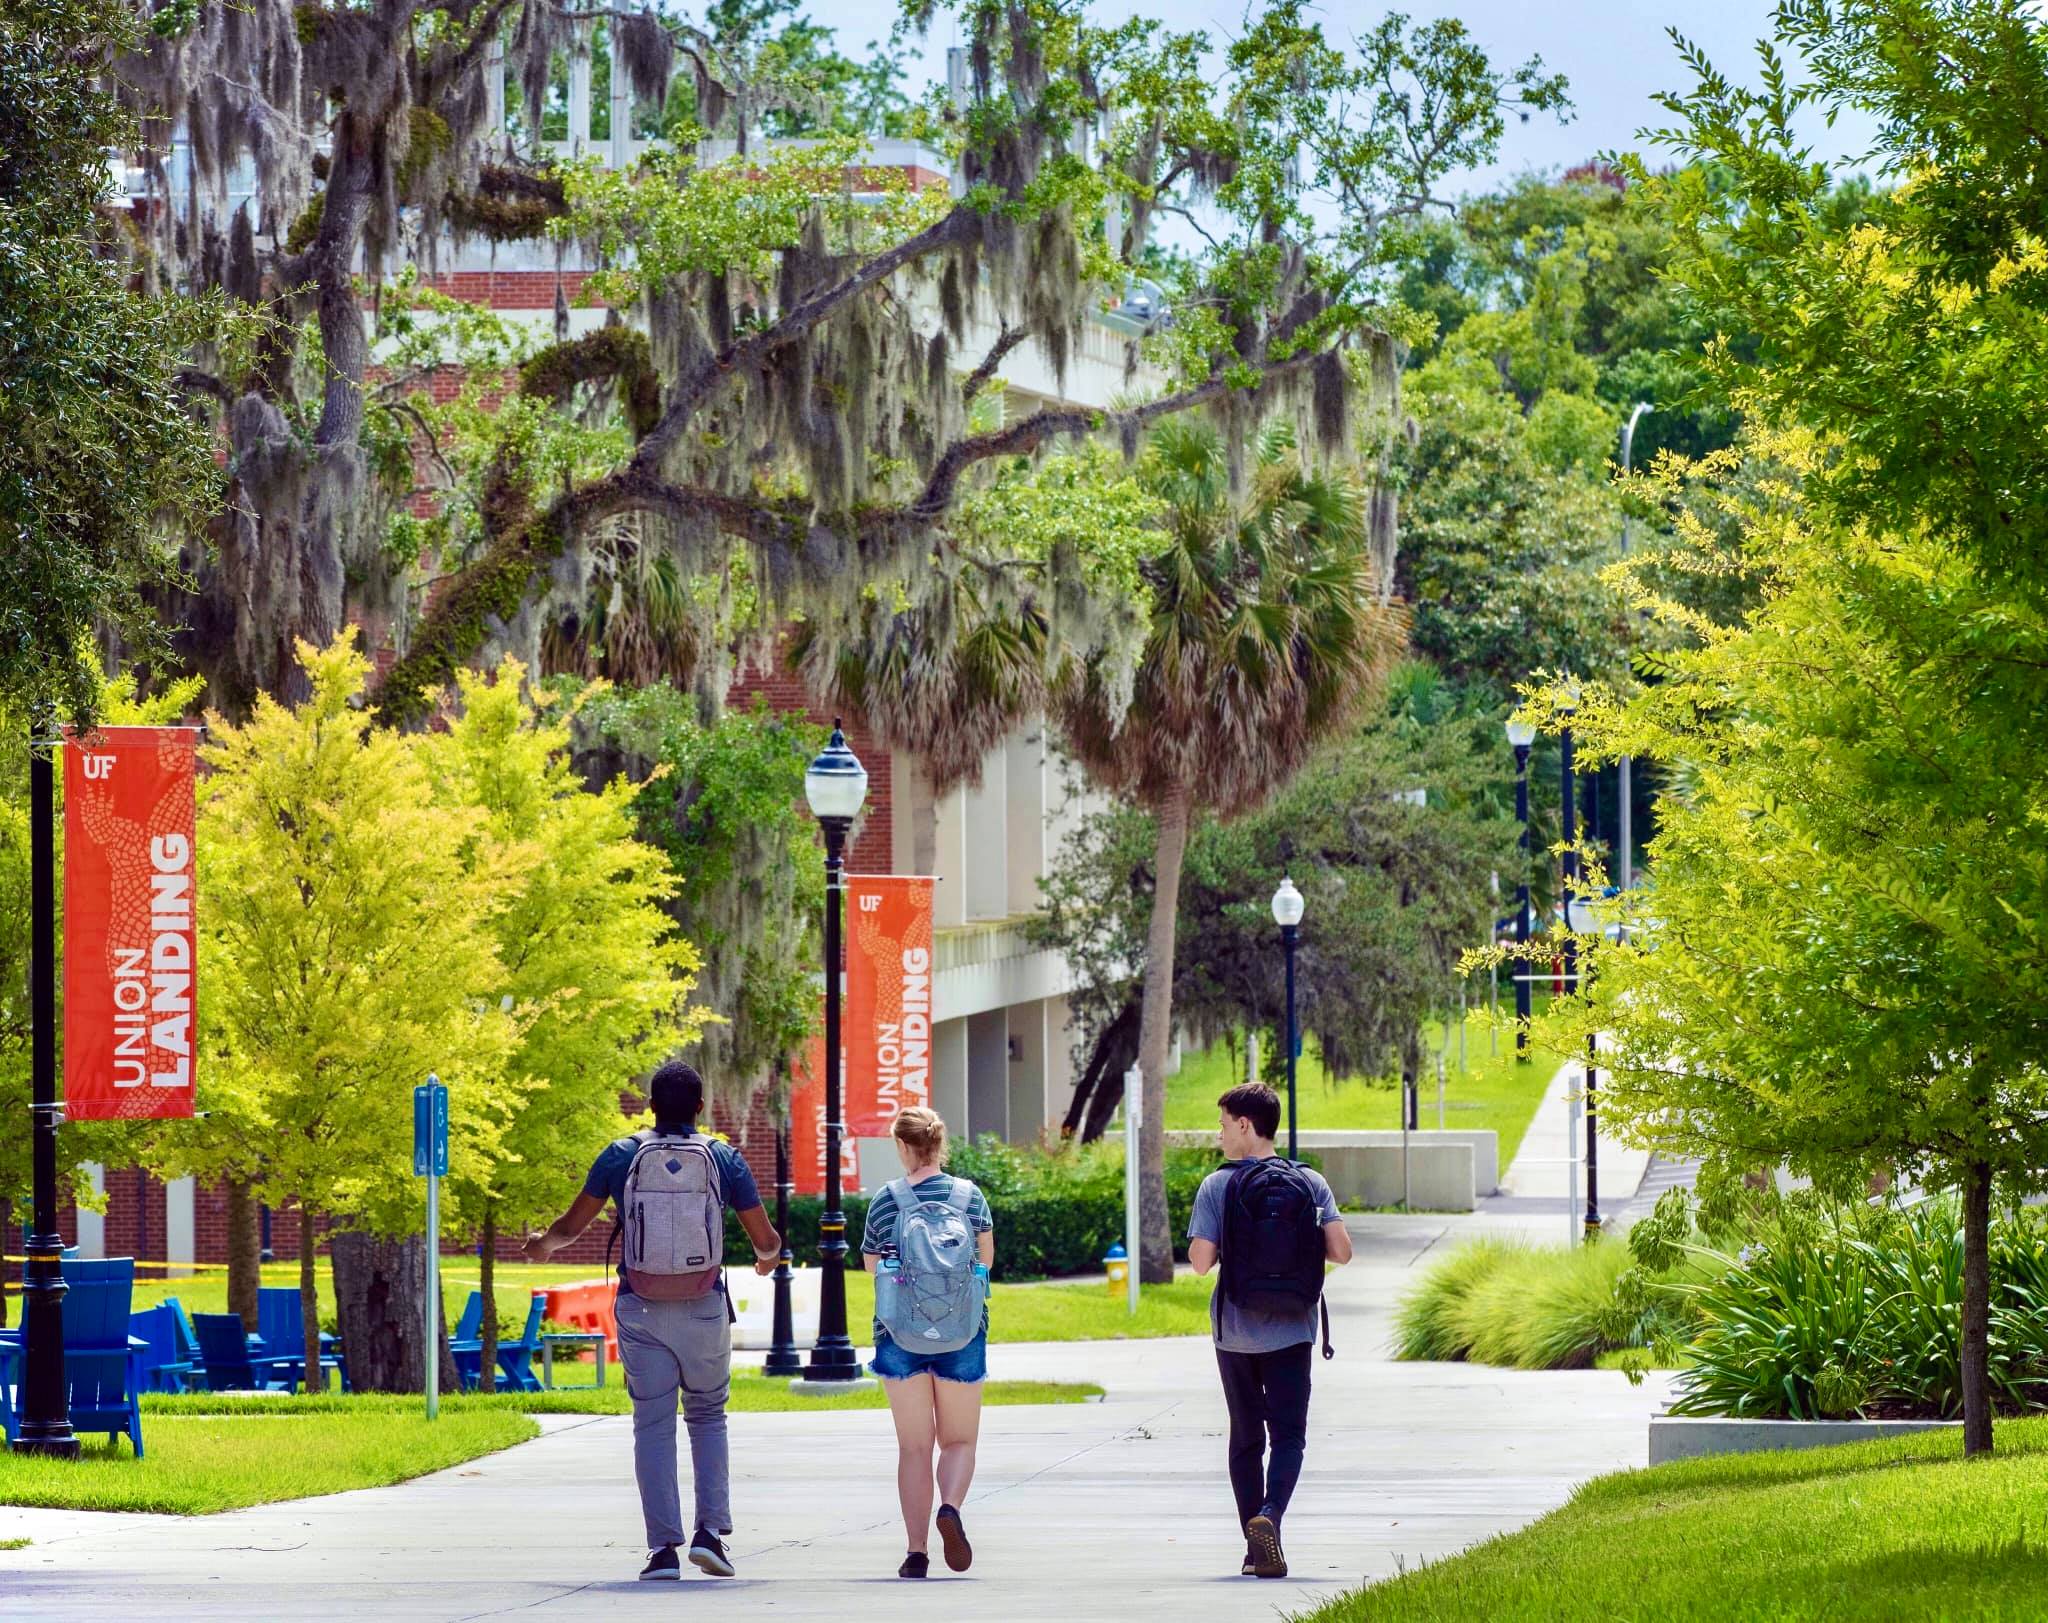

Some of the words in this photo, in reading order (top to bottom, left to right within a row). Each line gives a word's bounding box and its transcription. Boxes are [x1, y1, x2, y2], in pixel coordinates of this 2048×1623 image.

[83, 755, 116, 779] UF
[859, 895, 883, 912] UF
[151, 833, 190, 1087] LANDING
[114, 949, 146, 1088] UNION
[877, 1024, 899, 1118] UNION
